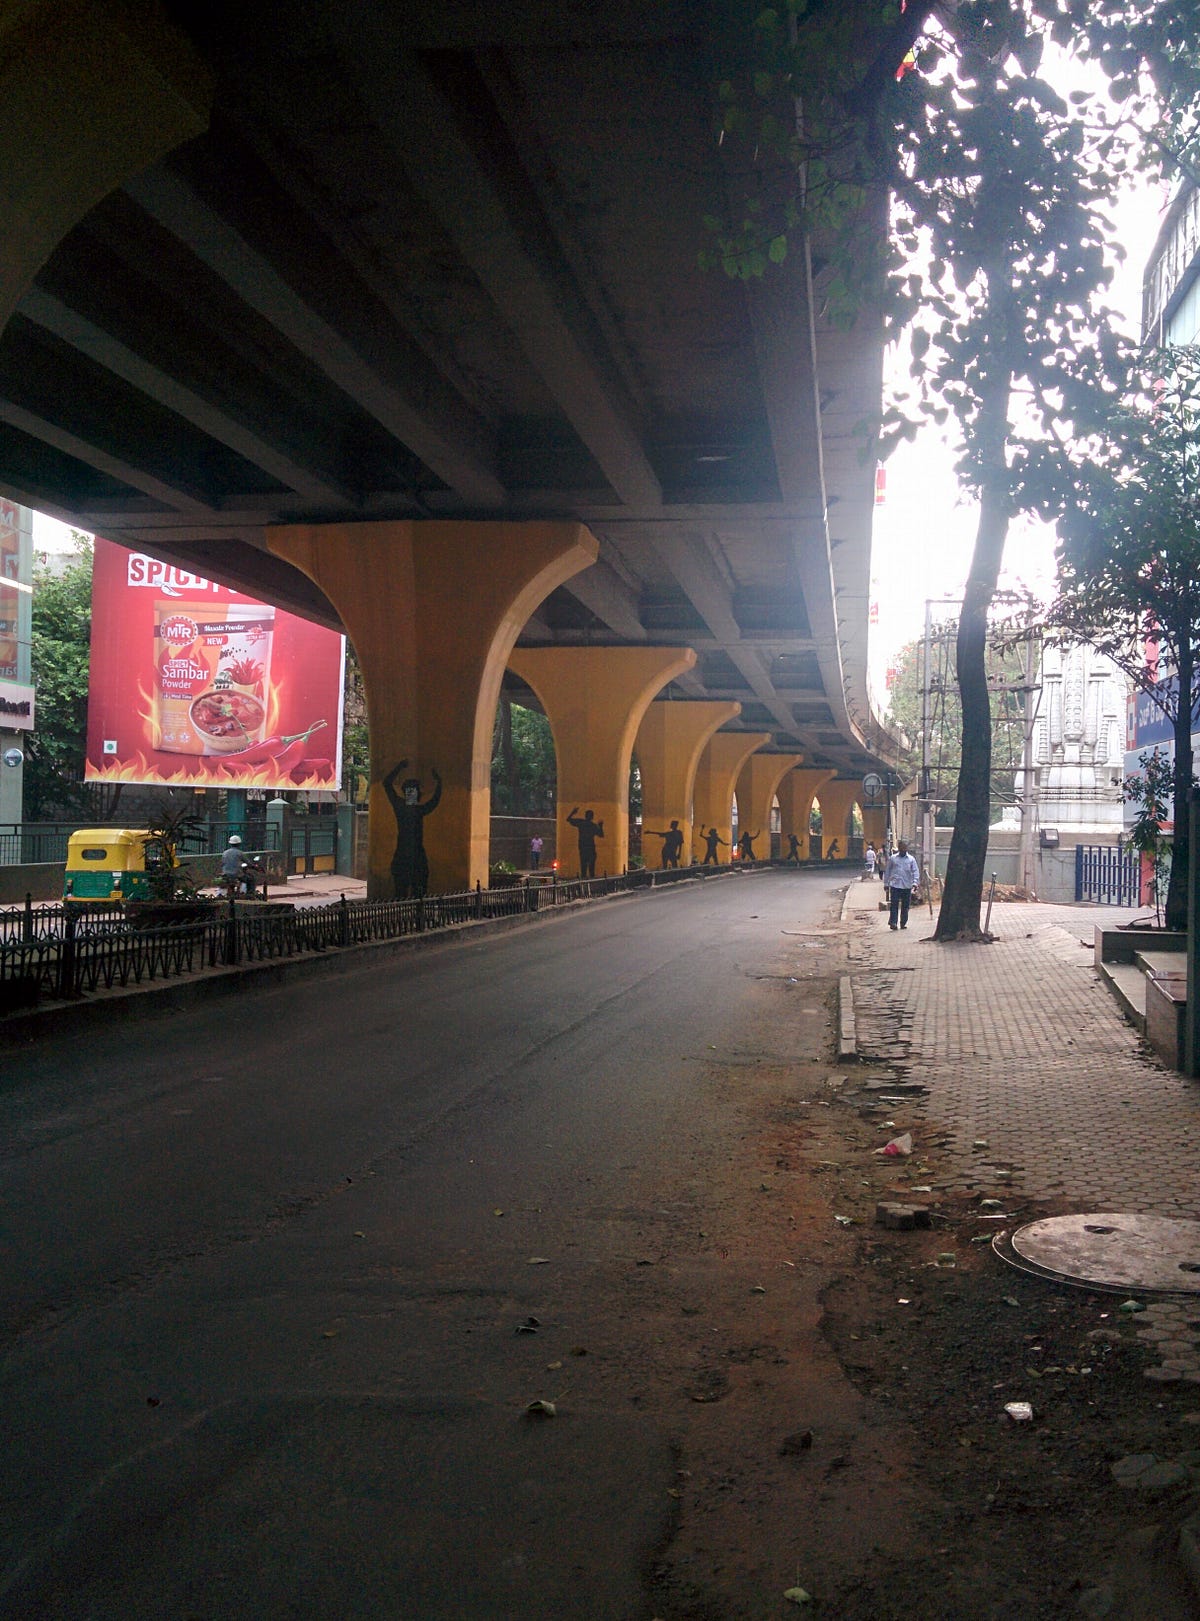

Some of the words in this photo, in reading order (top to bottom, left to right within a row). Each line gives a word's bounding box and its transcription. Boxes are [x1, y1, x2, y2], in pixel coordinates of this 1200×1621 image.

[167, 623, 192, 638] MTR
[207, 637, 223, 646] NEW
[162, 664, 209, 680] Sambar
[162, 679, 192, 688] Powder
